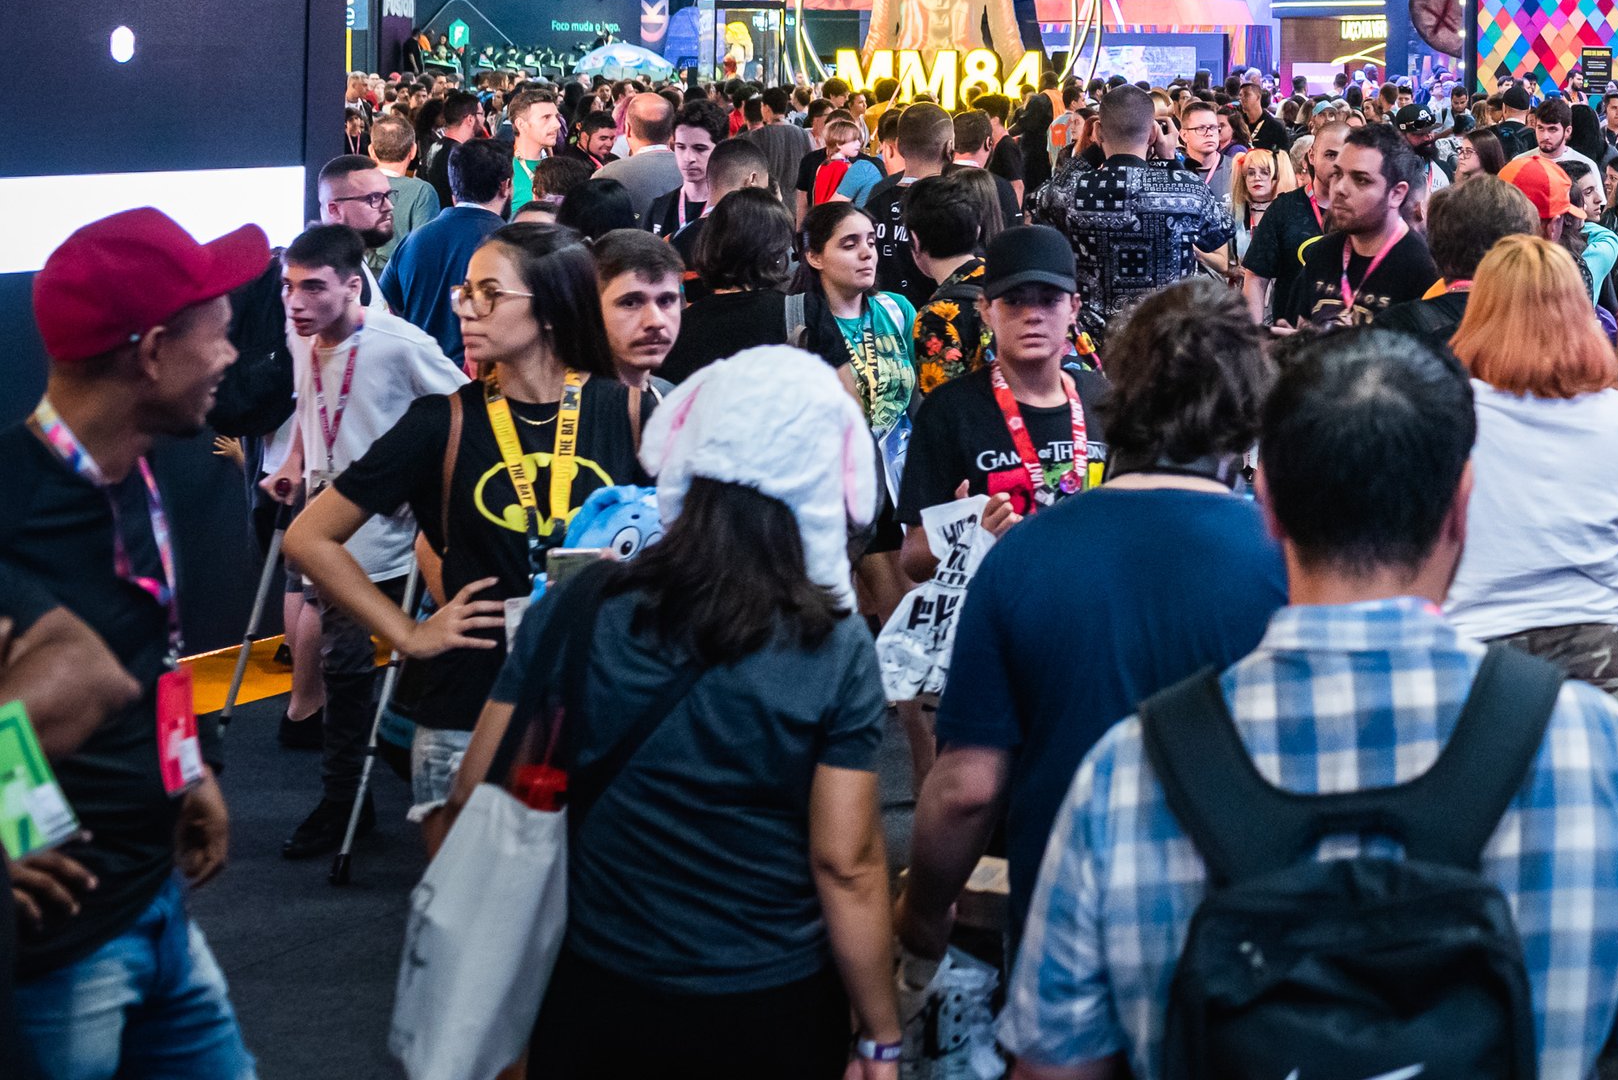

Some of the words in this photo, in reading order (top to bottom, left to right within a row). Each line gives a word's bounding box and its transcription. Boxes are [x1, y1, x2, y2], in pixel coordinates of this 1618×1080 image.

[551, 19, 570, 31] Foco
[835, 48, 1042, 112] MM84
[560, 418, 576, 436] BAT
[558, 439, 572, 457] THE
[976, 449, 1022, 472] GAM
